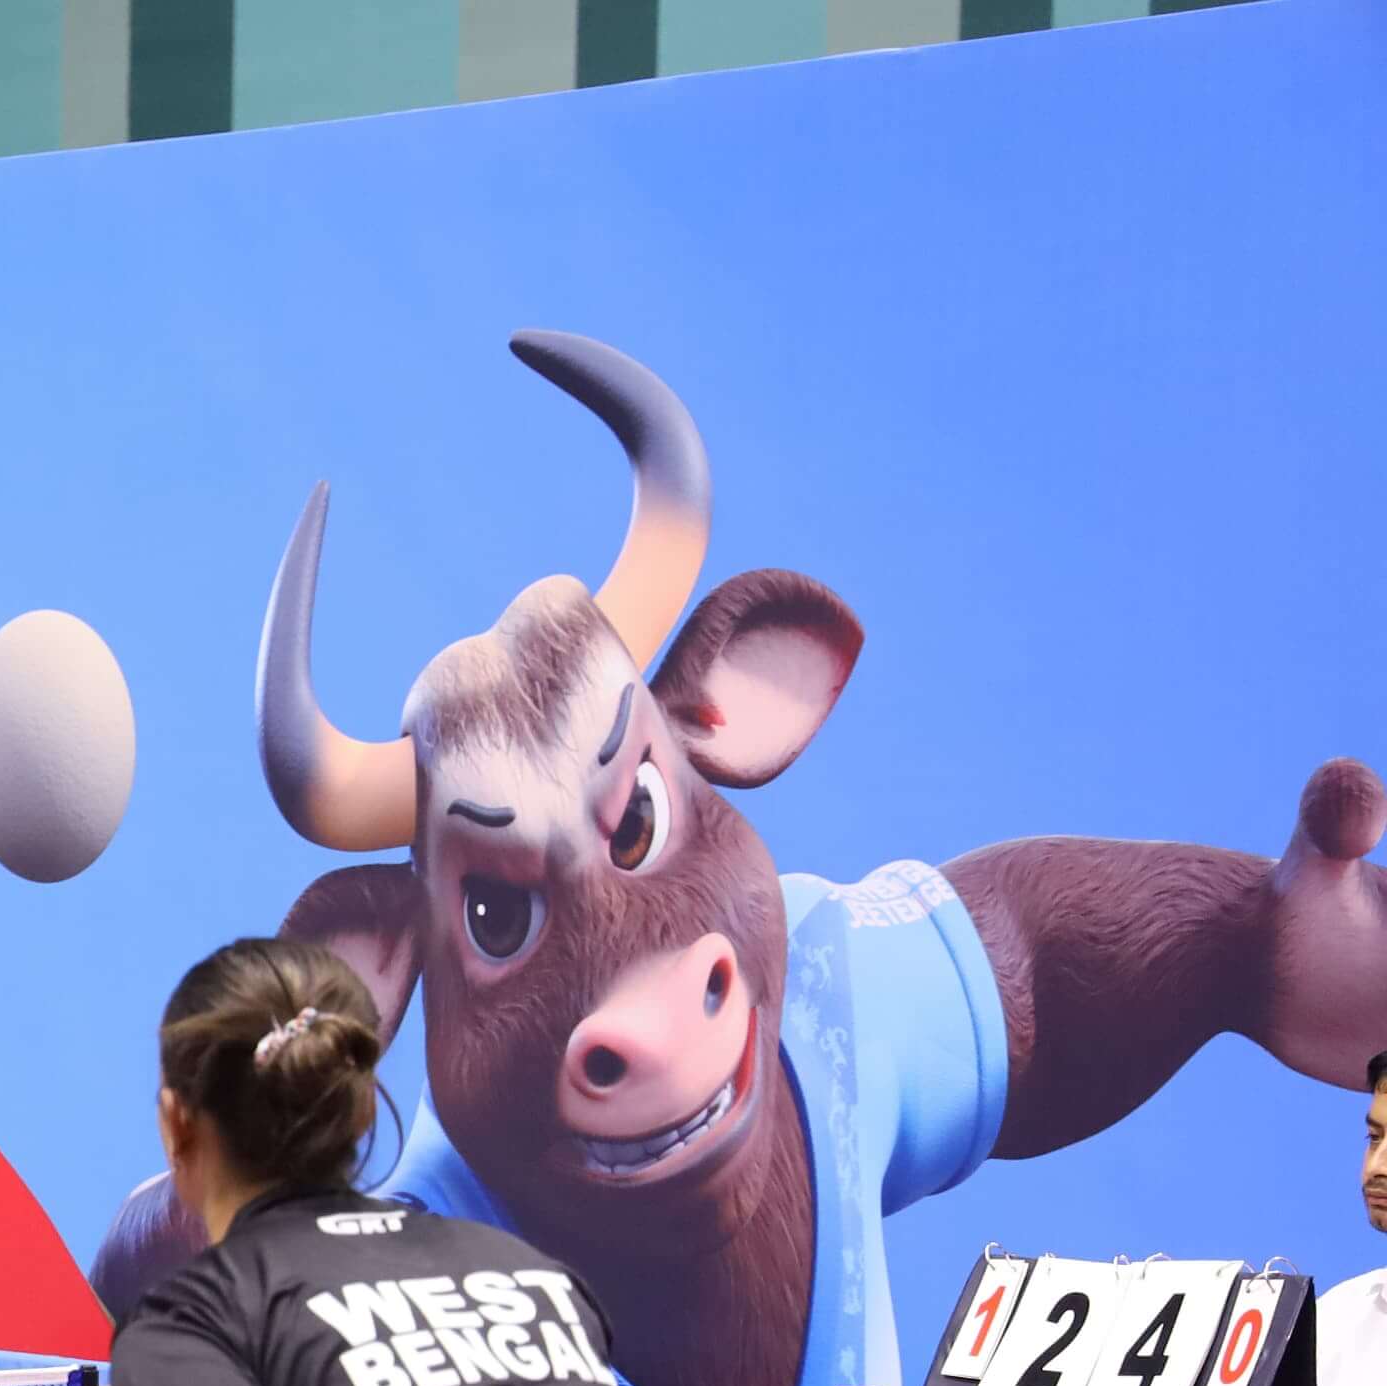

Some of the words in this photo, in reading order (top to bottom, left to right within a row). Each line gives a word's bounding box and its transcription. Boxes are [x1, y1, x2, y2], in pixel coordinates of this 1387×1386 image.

[307, 1270, 578, 1349] WEST
[969, 1285, 1006, 1358] 1
[1219, 1308, 1263, 1385] 0
